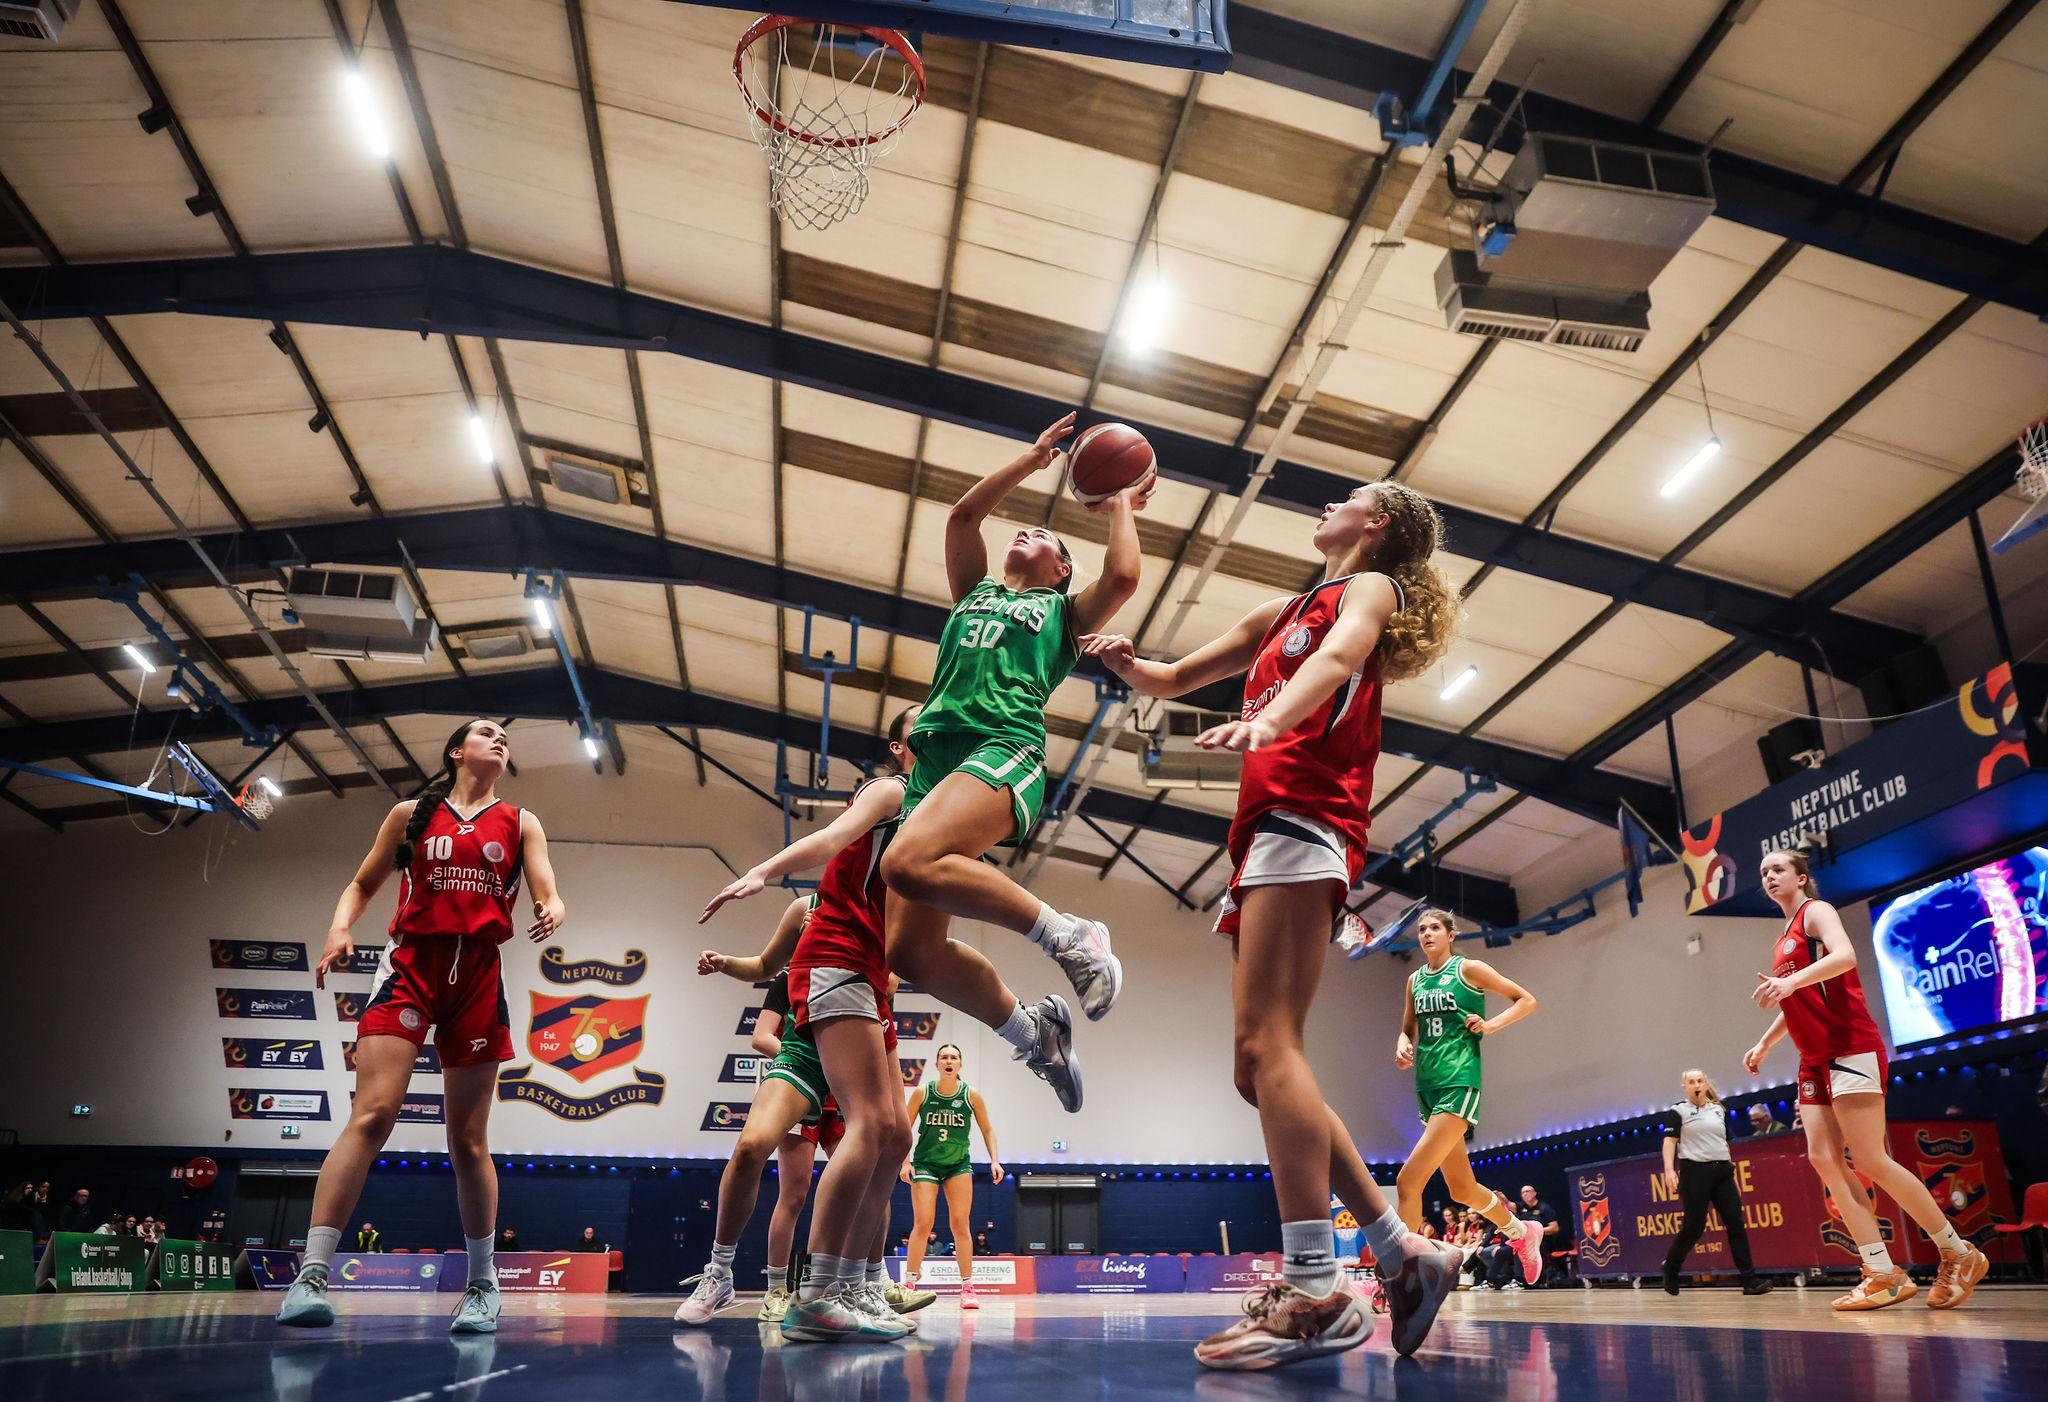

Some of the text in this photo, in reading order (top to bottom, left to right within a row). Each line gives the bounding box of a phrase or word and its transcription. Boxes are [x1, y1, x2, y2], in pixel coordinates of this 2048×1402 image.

[960, 618, 1006, 649] 30
[1790, 769, 1863, 820] NEPTUNE
[1862, 774, 1908, 812] CLUB
[424, 835, 453, 861] 10
[433, 866, 503, 885] simmons
[561, 966, 623, 981] NEPTUNE
[543, 1030, 557, 1040] Est.
[569, 1007, 608, 1062] 75
[1425, 1017, 1443, 1037] 18
[540, 1042, 560, 1052] 1947
[262, 1050, 308, 1063] EY EY
[516, 1085, 647, 1117] BASKETBALL CLUB
[926, 1111, 965, 1127] CELTICS
[938, 1128, 948, 1142] 3
[1707, 1241, 1723, 1253] 1947
[930, 1266, 1011, 1274] ASHDA CATERING
[1075, 1258, 1146, 1279] EZ living
[539, 1270, 565, 1286] EY
